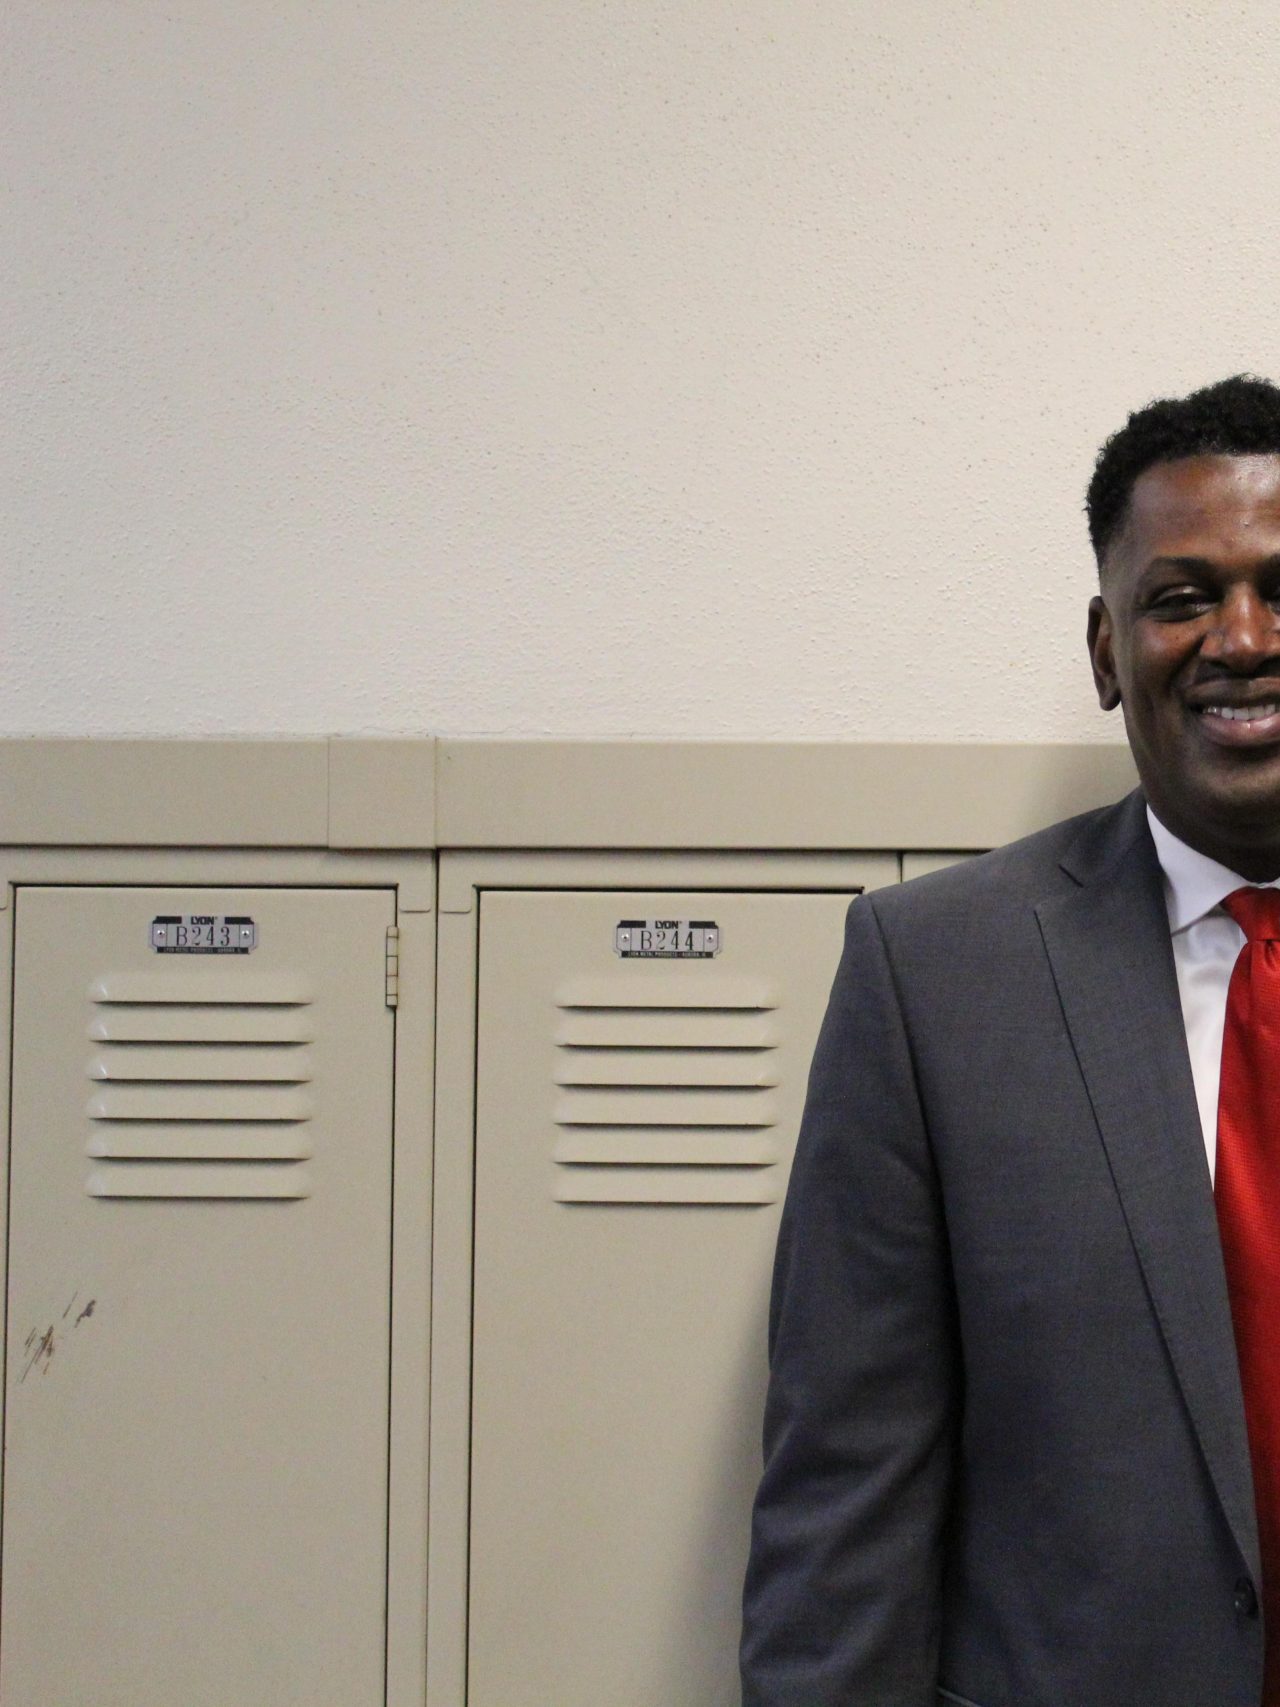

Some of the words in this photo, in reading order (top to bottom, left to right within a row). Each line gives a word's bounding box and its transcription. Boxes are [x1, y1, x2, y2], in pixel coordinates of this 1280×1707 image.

[191, 916, 214, 925] LYON
[655, 921, 679, 929] LYON
[176, 926, 230, 946] B243
[641, 930, 694, 951] B244
